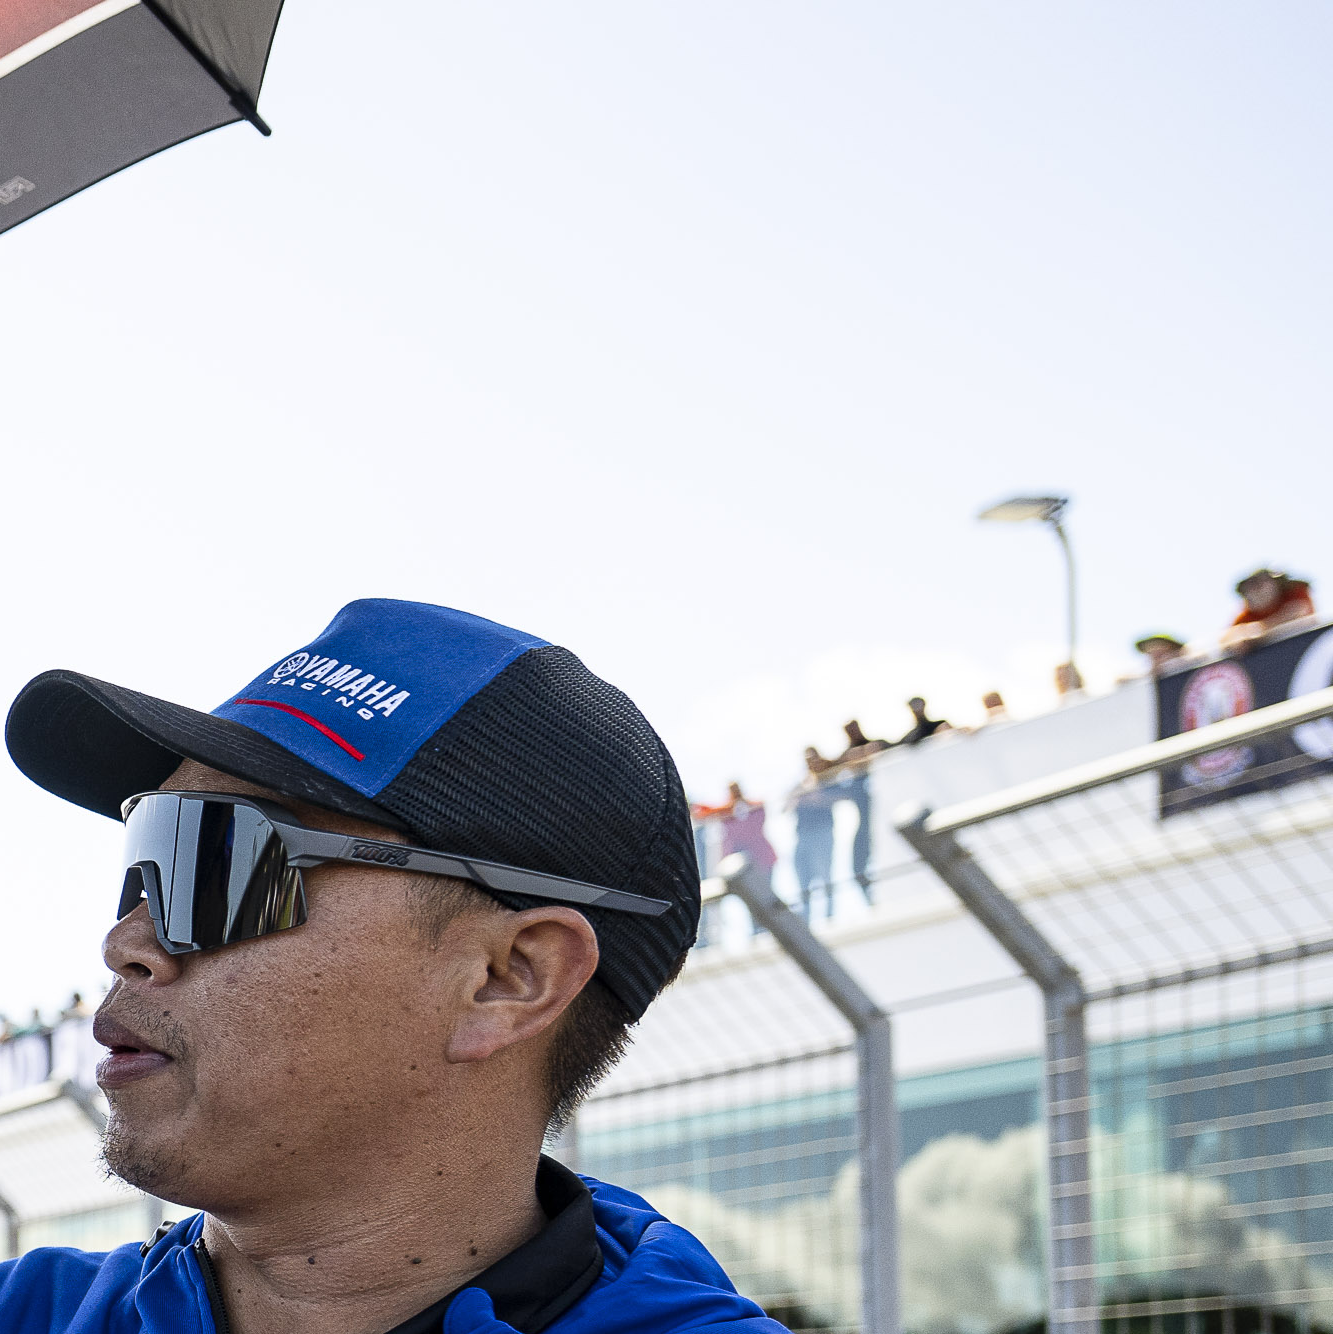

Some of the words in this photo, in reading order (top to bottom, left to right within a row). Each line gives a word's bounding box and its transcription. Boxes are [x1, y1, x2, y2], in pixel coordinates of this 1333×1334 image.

[267, 677, 375, 720] RACING
[296, 653, 411, 718] YAMAHA
[351, 844, 412, 867] 100%
